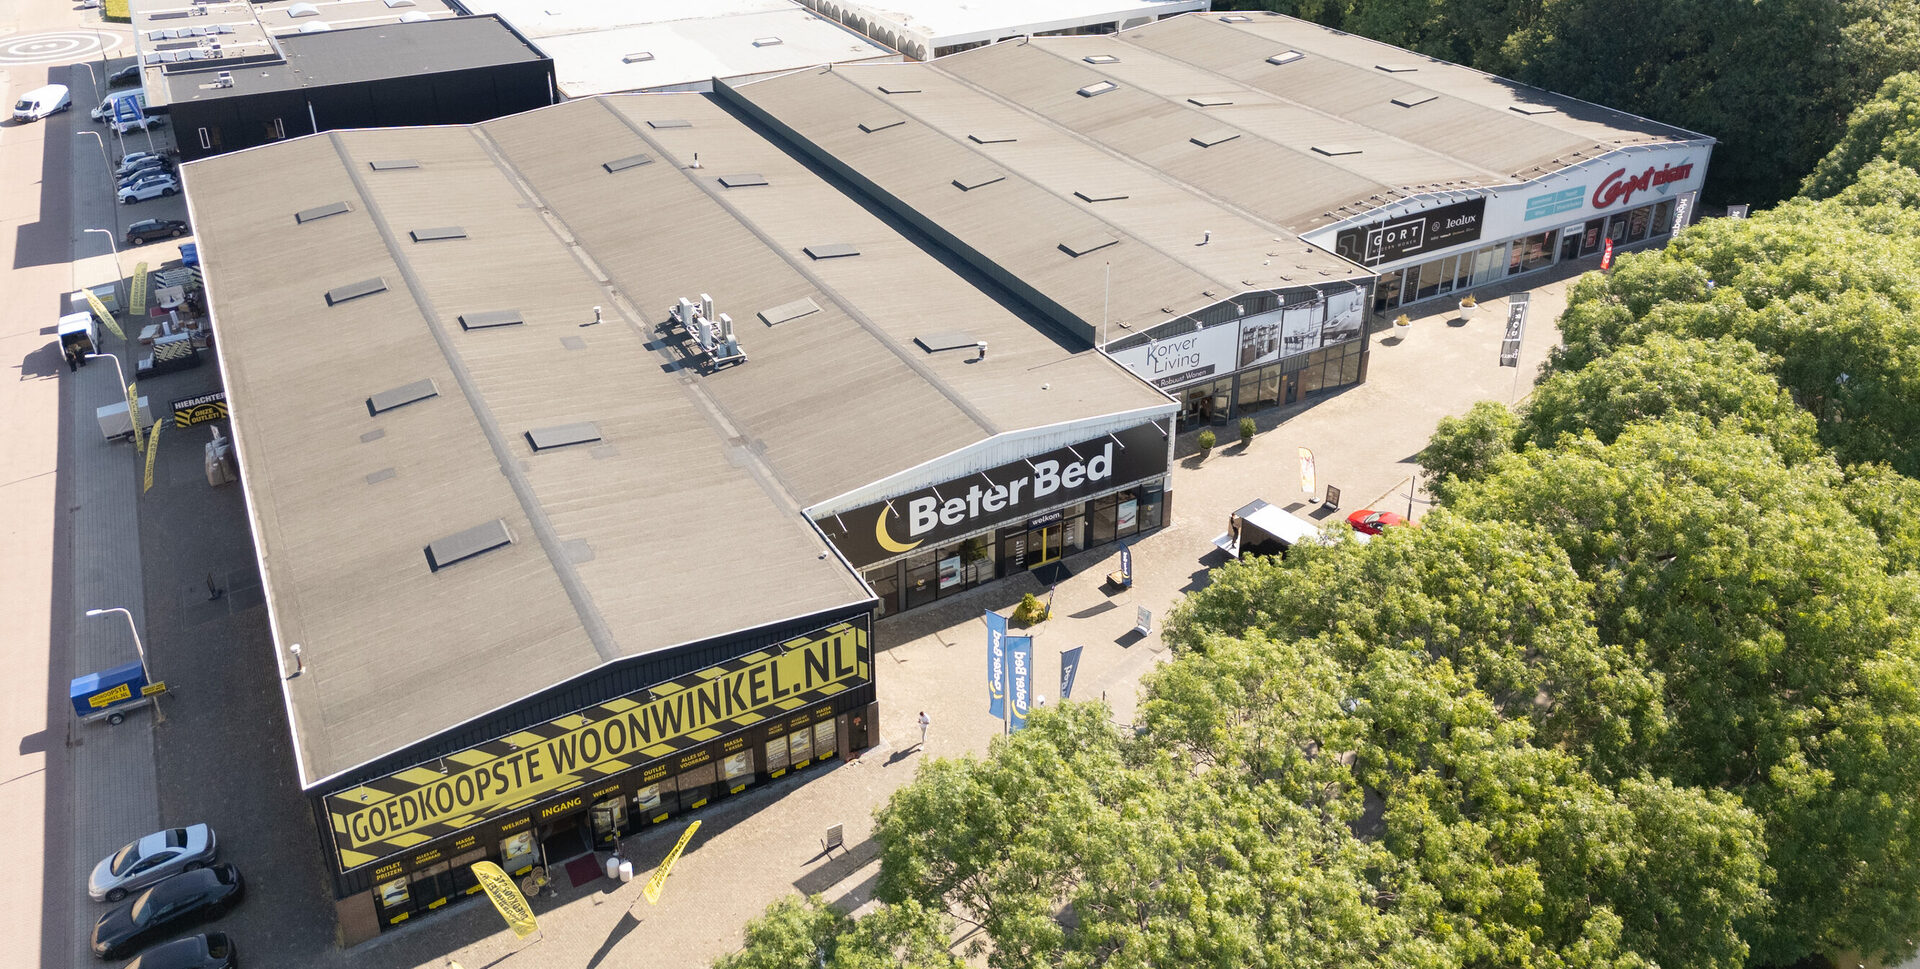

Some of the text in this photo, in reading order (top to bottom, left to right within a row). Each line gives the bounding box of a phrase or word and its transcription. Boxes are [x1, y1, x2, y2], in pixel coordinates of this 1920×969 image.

[1446, 214, 1476, 229] leolux
[1373, 226, 1418, 246] GORT
[1146, 337, 1198, 366] Korver
[1154, 352, 1200, 374] Living
[191, 412, 219, 424] OUTLET!
[195, 407, 214, 417] ONZE
[909, 442, 1113, 537] Beter Bed
[1031, 512, 1060, 526] welkom
[352, 636, 854, 843] GOEDKOOPSTE WOONWINKEL.NL
[724, 737, 743, 748] MASSA
[680, 755, 710, 769] VOORRAAD
[681, 753, 696, 763] ALLES
[643, 764, 666, 777] OUTLET
[644, 770, 667, 782] PRIJZEN
[592, 784, 619, 798] WELKOM
[541, 797, 582, 818] INGANG
[501, 817, 530, 832] WELKOM
[455, 835, 475, 847] MASSA
[415, 853, 441, 865] VOORRAAD
[416, 852, 428, 861] ALLES
[375, 861, 401, 875] OUTLET
[376, 867, 403, 880] PRIJZEN
